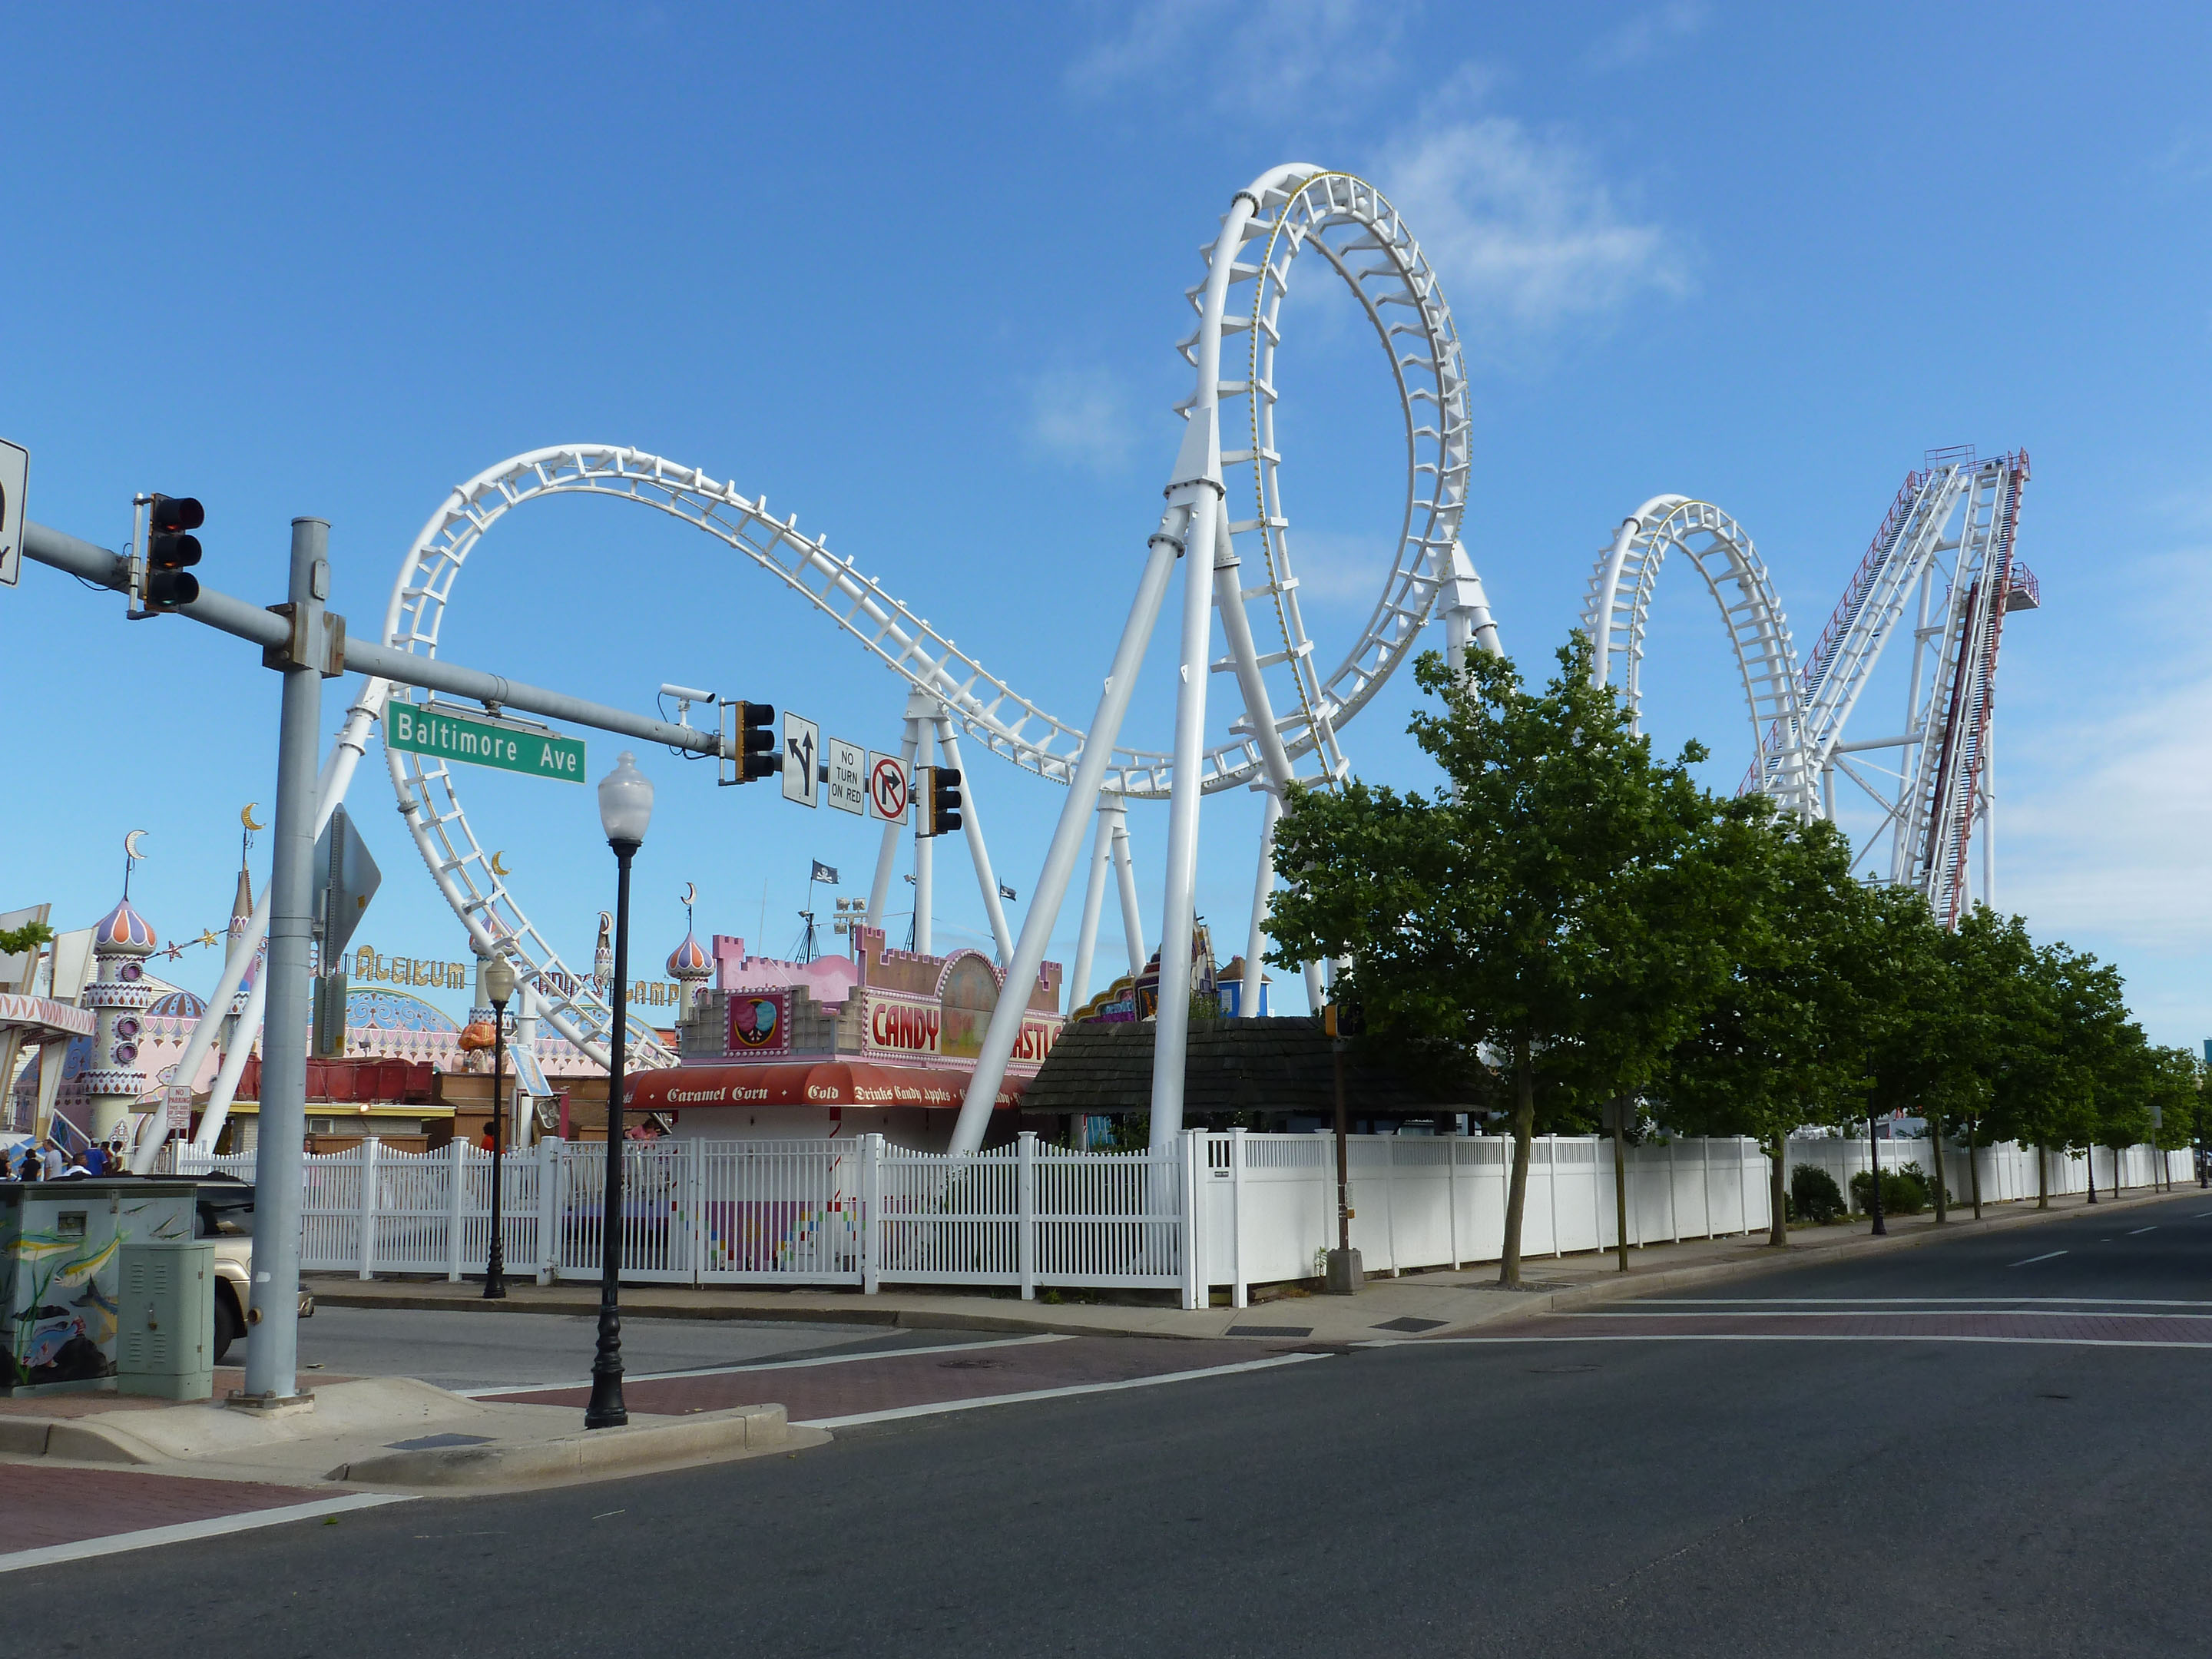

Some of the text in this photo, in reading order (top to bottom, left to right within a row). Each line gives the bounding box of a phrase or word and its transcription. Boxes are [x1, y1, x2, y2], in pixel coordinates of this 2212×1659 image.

[398, 713, 577, 772] Baltimore Ave
[841, 750, 854, 766] NO
[836, 767, 858, 785] TURN
[832, 783, 861, 803] ON RED
[873, 1003, 1062, 1061] CANDY ASTL
[667, 1087, 727, 1102] Caramel
[732, 1086, 769, 1101] Corn
[807, 1084, 839, 1100] Cold
[854, 1085, 893, 1101] Drinks
[894, 1085, 922, 1107] Candy
[924, 1087, 951, 1104] Apples
